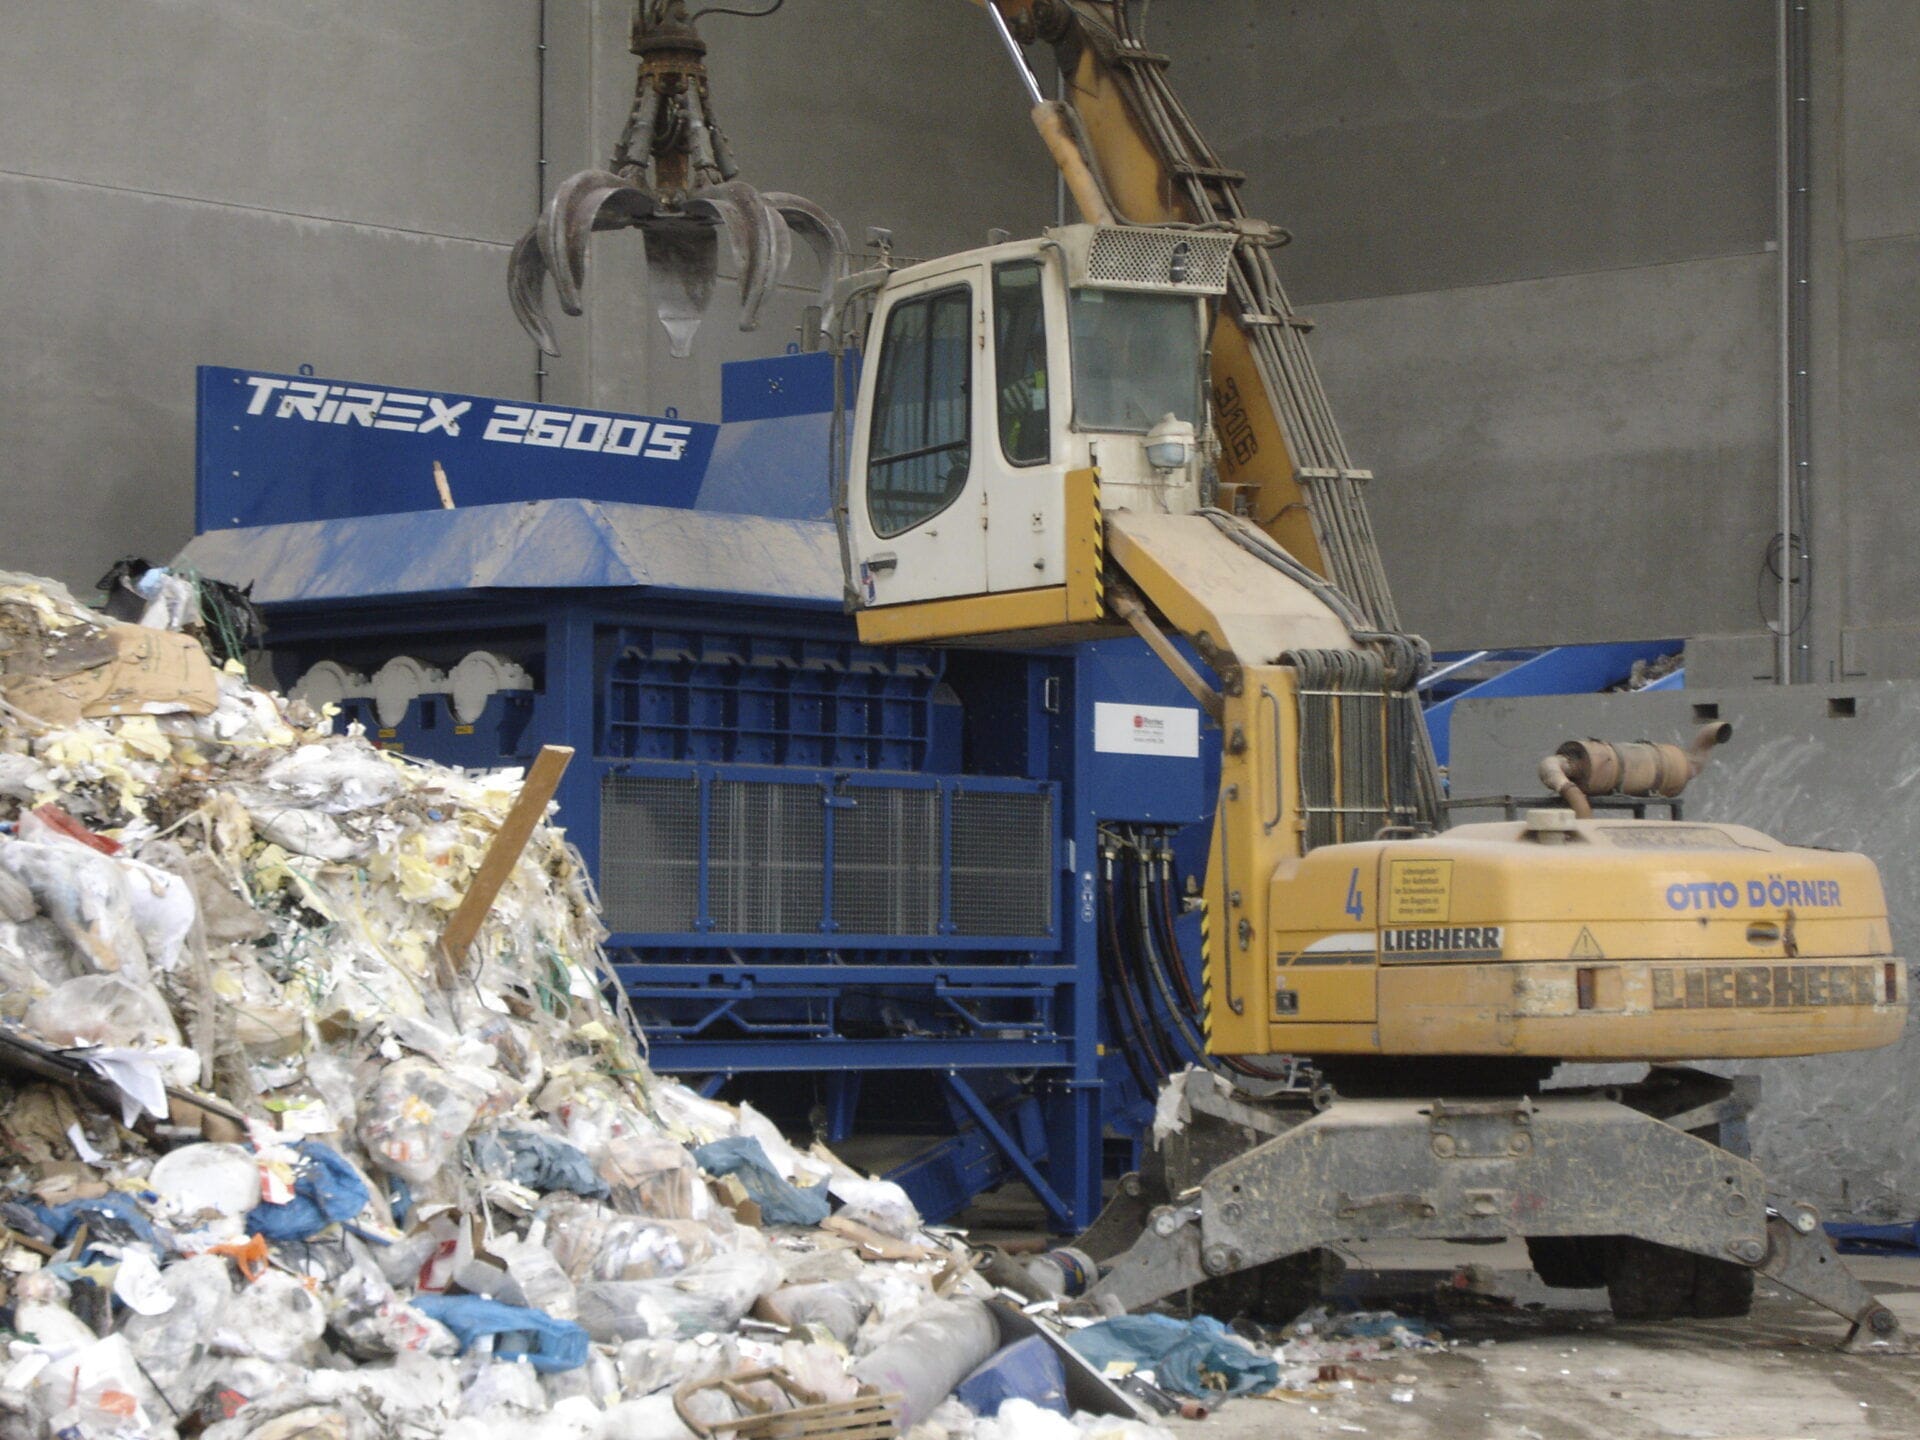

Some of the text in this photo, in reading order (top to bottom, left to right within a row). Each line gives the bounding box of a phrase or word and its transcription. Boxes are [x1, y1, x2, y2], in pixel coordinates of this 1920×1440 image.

[482, 404, 692, 461] 2600S
[1345, 867, 1364, 922] 4
[1666, 873, 1842, 911] OTTO DÖRNER
[1384, 927, 1500, 951] LIEBHERR
